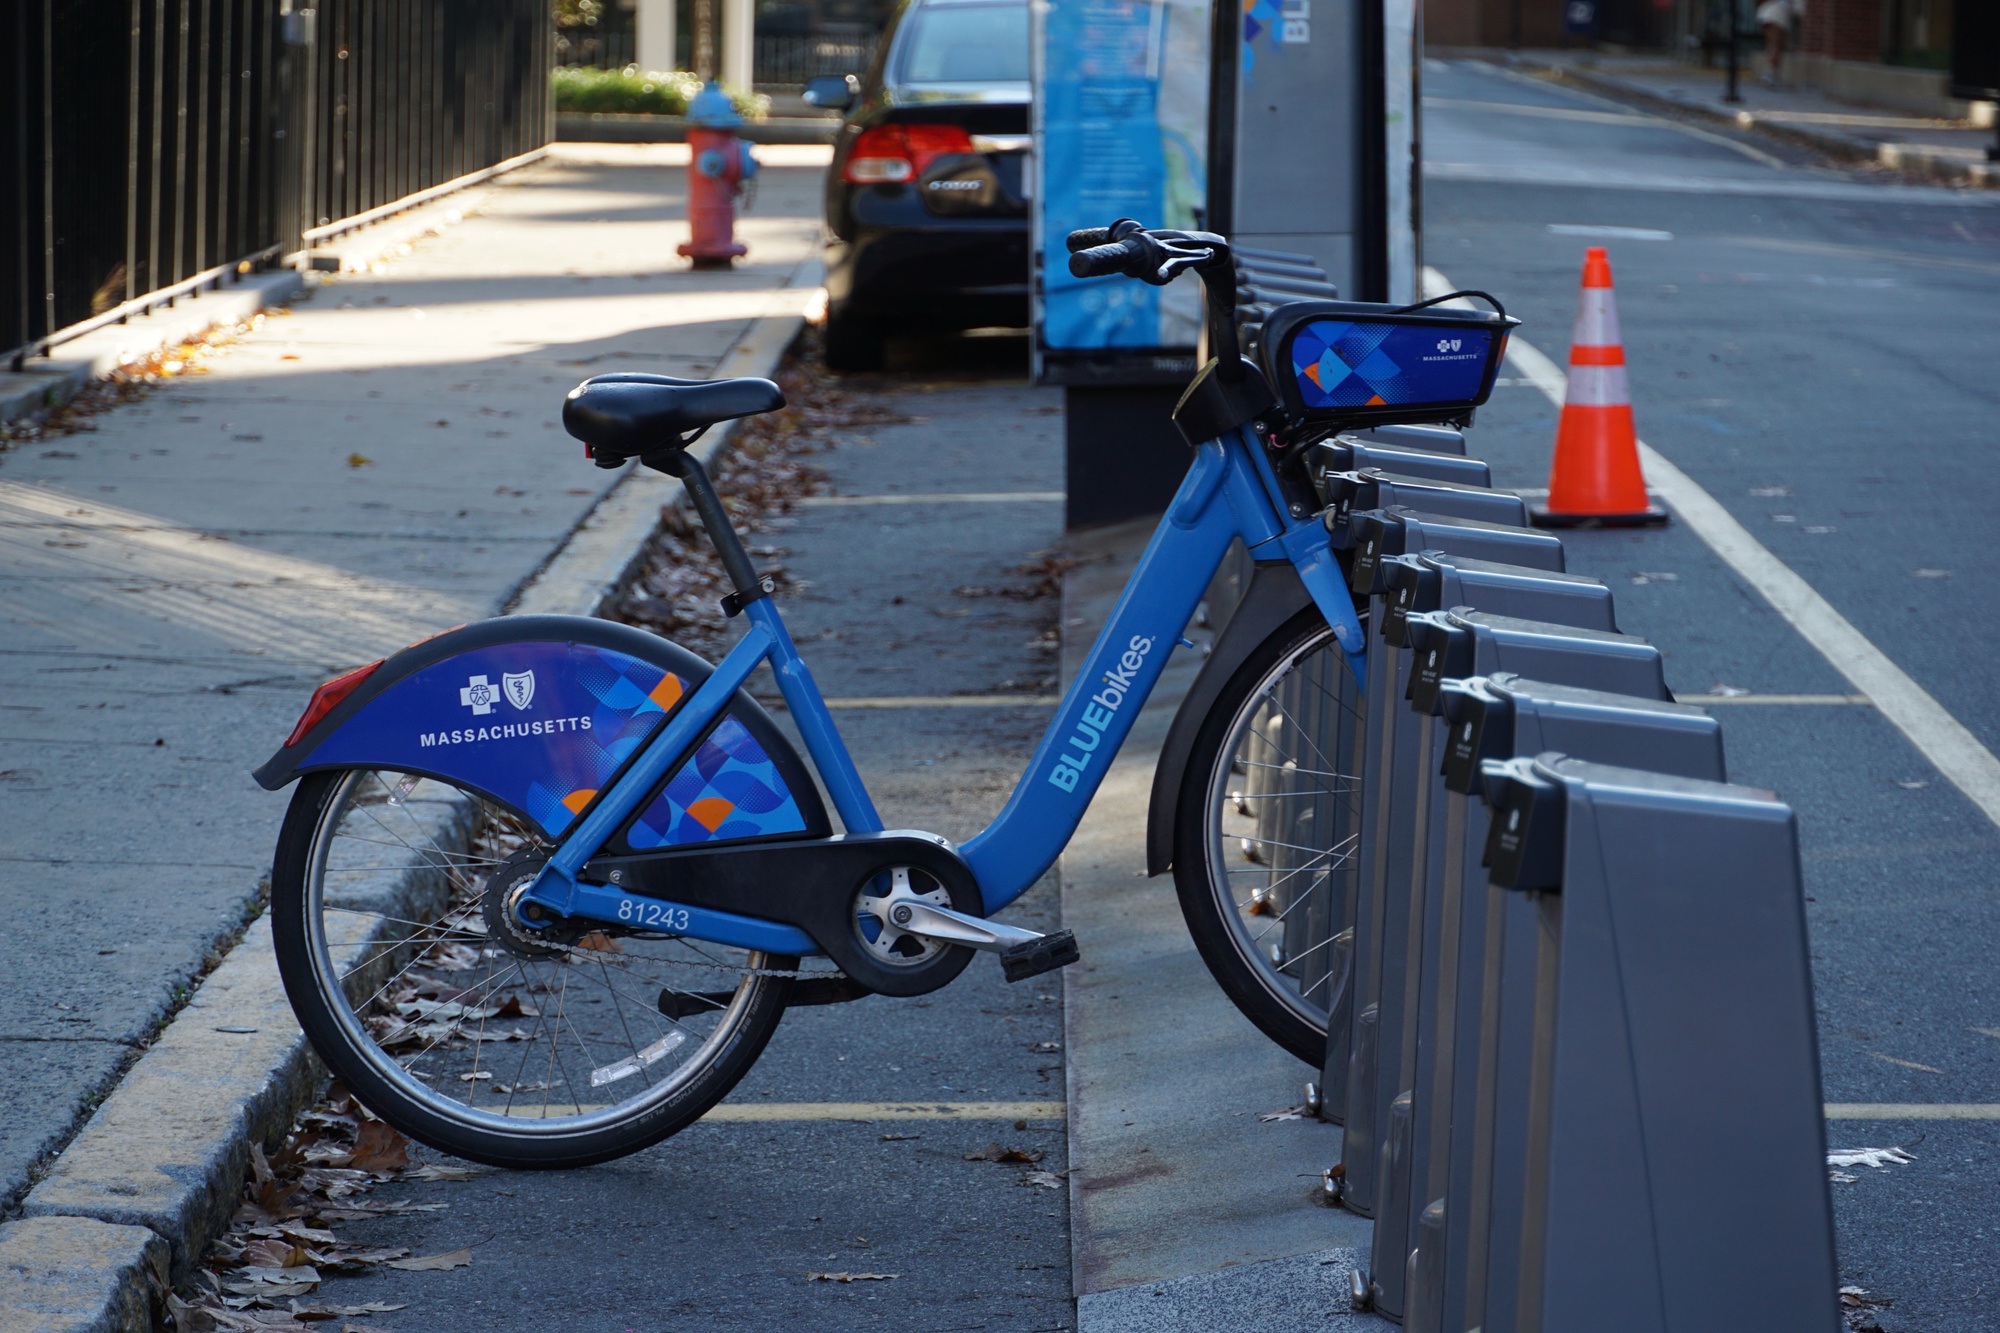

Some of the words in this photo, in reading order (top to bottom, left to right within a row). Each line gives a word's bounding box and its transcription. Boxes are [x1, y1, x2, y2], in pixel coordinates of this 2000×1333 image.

[1048, 634, 1152, 793] BLUEbikes
[420, 716, 592, 748] MASSACHUSETTS
[618, 899, 689, 931] 81243
